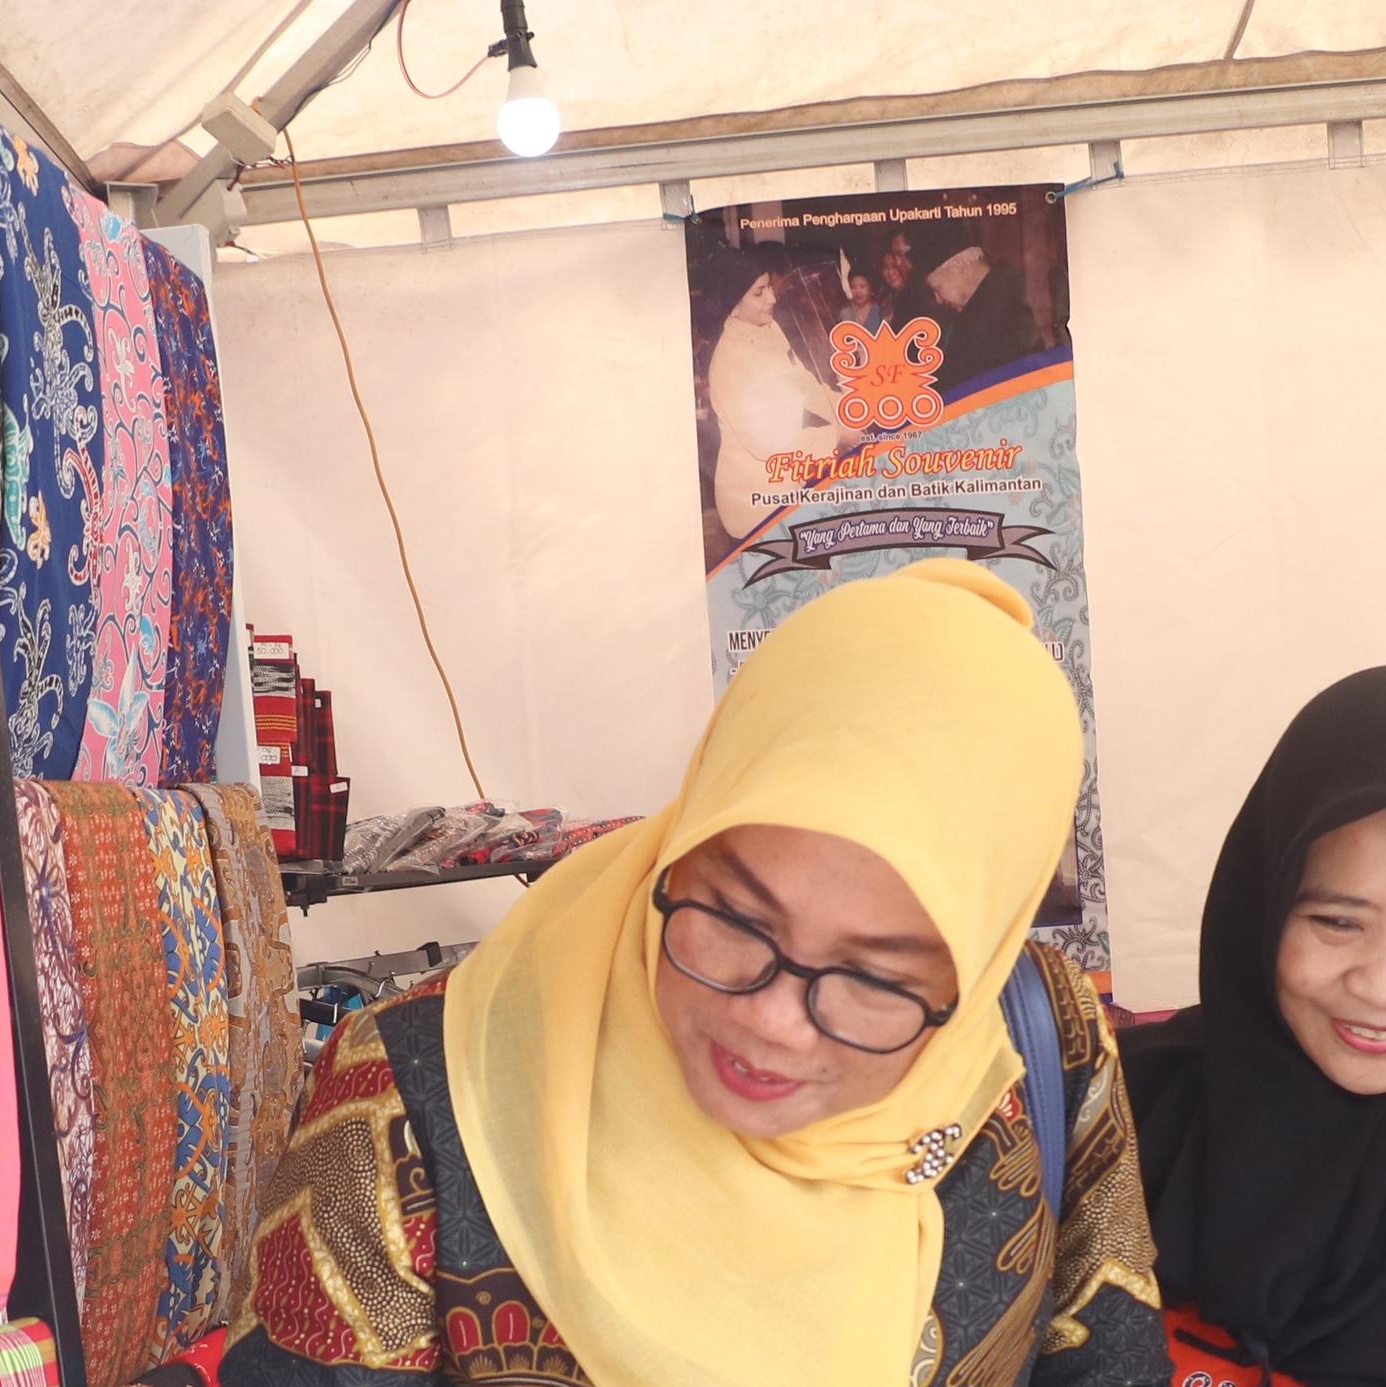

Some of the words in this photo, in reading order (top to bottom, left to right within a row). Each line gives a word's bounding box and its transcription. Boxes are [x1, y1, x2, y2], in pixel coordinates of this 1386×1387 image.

[740, 216, 800, 230] Penerima
[803, 210, 886, 227] Penghargaan
[889, 206, 942, 222] Upakarti
[944, 204, 982, 218] Tahun
[986, 202, 1018, 216] 1995
[870, 364, 905, 387] SF
[878, 432, 901, 441] since
[766, 444, 876, 483] Fitriah
[882, 438, 1023, 480] Souvenir
[751, 492, 797, 506] Pusat
[800, 488, 873, 504] Kerajinan
[878, 485, 906, 499] dan
[911, 482, 950, 497] Batik
[955, 478, 1042, 494] Kalimantan
[837, 520, 886, 542] Pertama
[889, 516, 910, 533] dan
[913, 517, 944, 540] Yang
[729, 630, 770, 651] MENY
